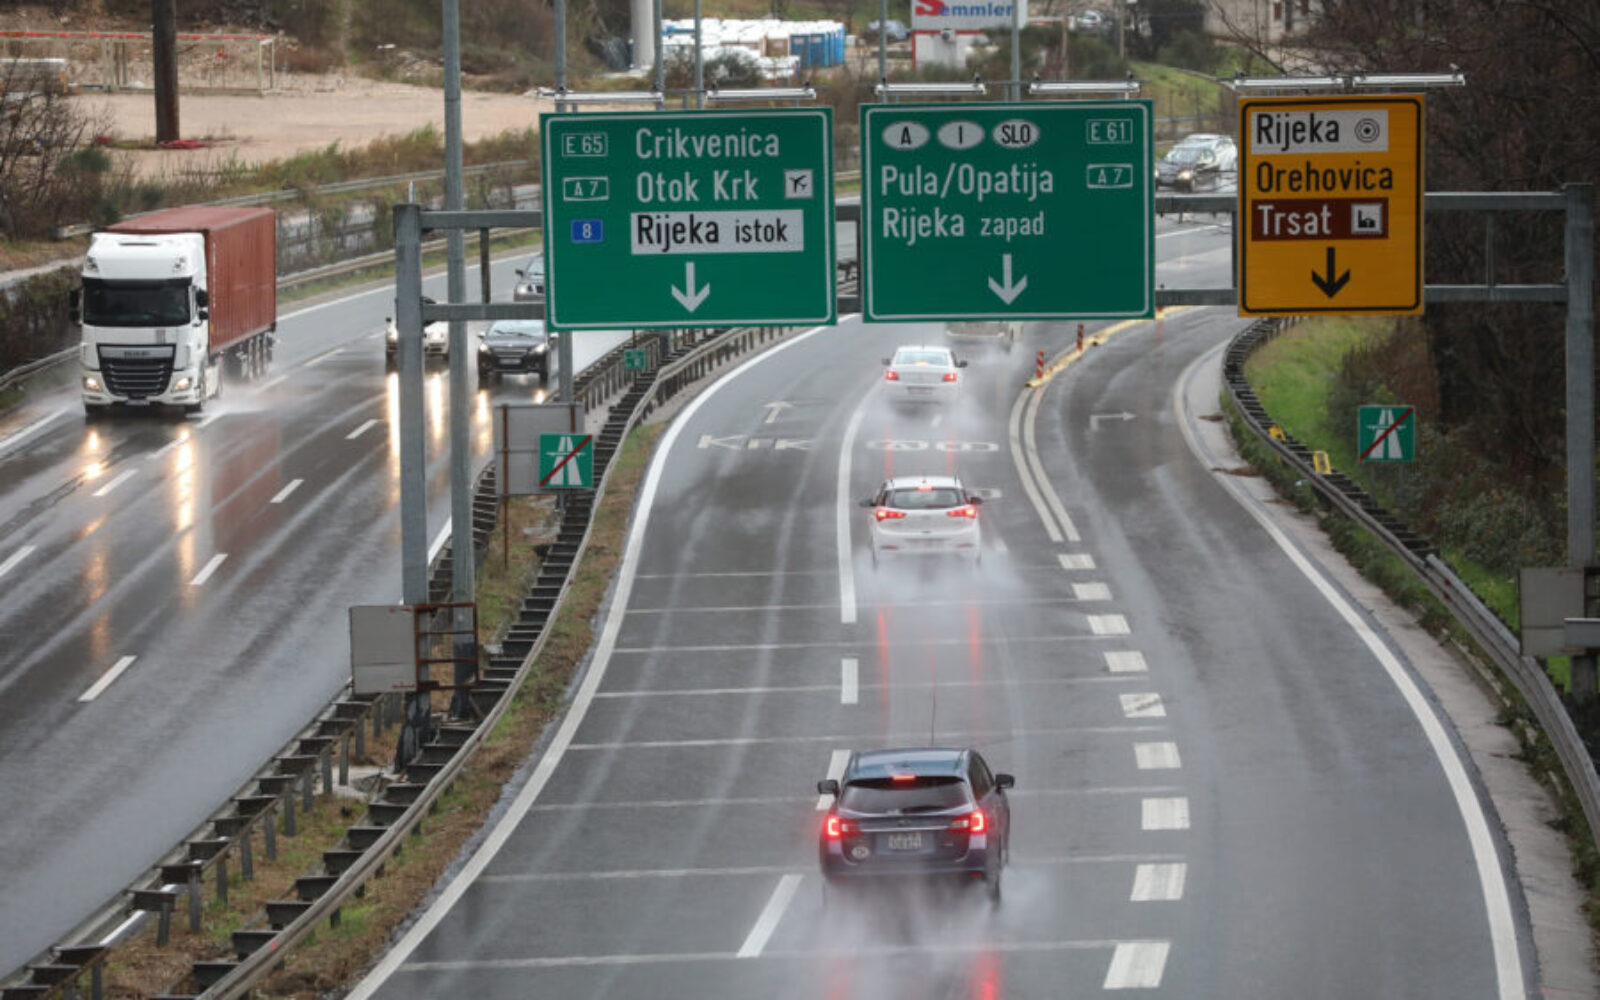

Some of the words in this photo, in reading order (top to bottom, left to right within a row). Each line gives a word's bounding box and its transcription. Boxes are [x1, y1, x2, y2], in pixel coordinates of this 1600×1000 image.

[566, 137, 576, 153] E
[582, 136, 603, 153] 65
[636, 128, 780, 158] Crikvenica
[901, 127, 912, 144] A
[1002, 125, 1030, 144] SLO
[1091, 124, 1100, 140] E
[1107, 123, 1126, 140] 61
[1257, 113, 1339, 151] Rijeka
[574, 182, 584, 196] A
[590, 181, 599, 195] 7
[637, 171, 699, 202] Otok
[713, 170, 759, 200] Krk
[881, 163, 1053, 201] Pula/Opatija
[1098, 170, 1107, 184] A
[1114, 169, 1122, 183] 7
[1257, 161, 1393, 193] Orehovica
[582, 223, 592, 239] 8
[637, 214, 719, 252] Rijeka
[735, 218, 788, 242] istok
[883, 207, 965, 246] Rijeka
[981, 211, 1045, 242] zapad
[1257, 204, 1332, 236] Trsat
